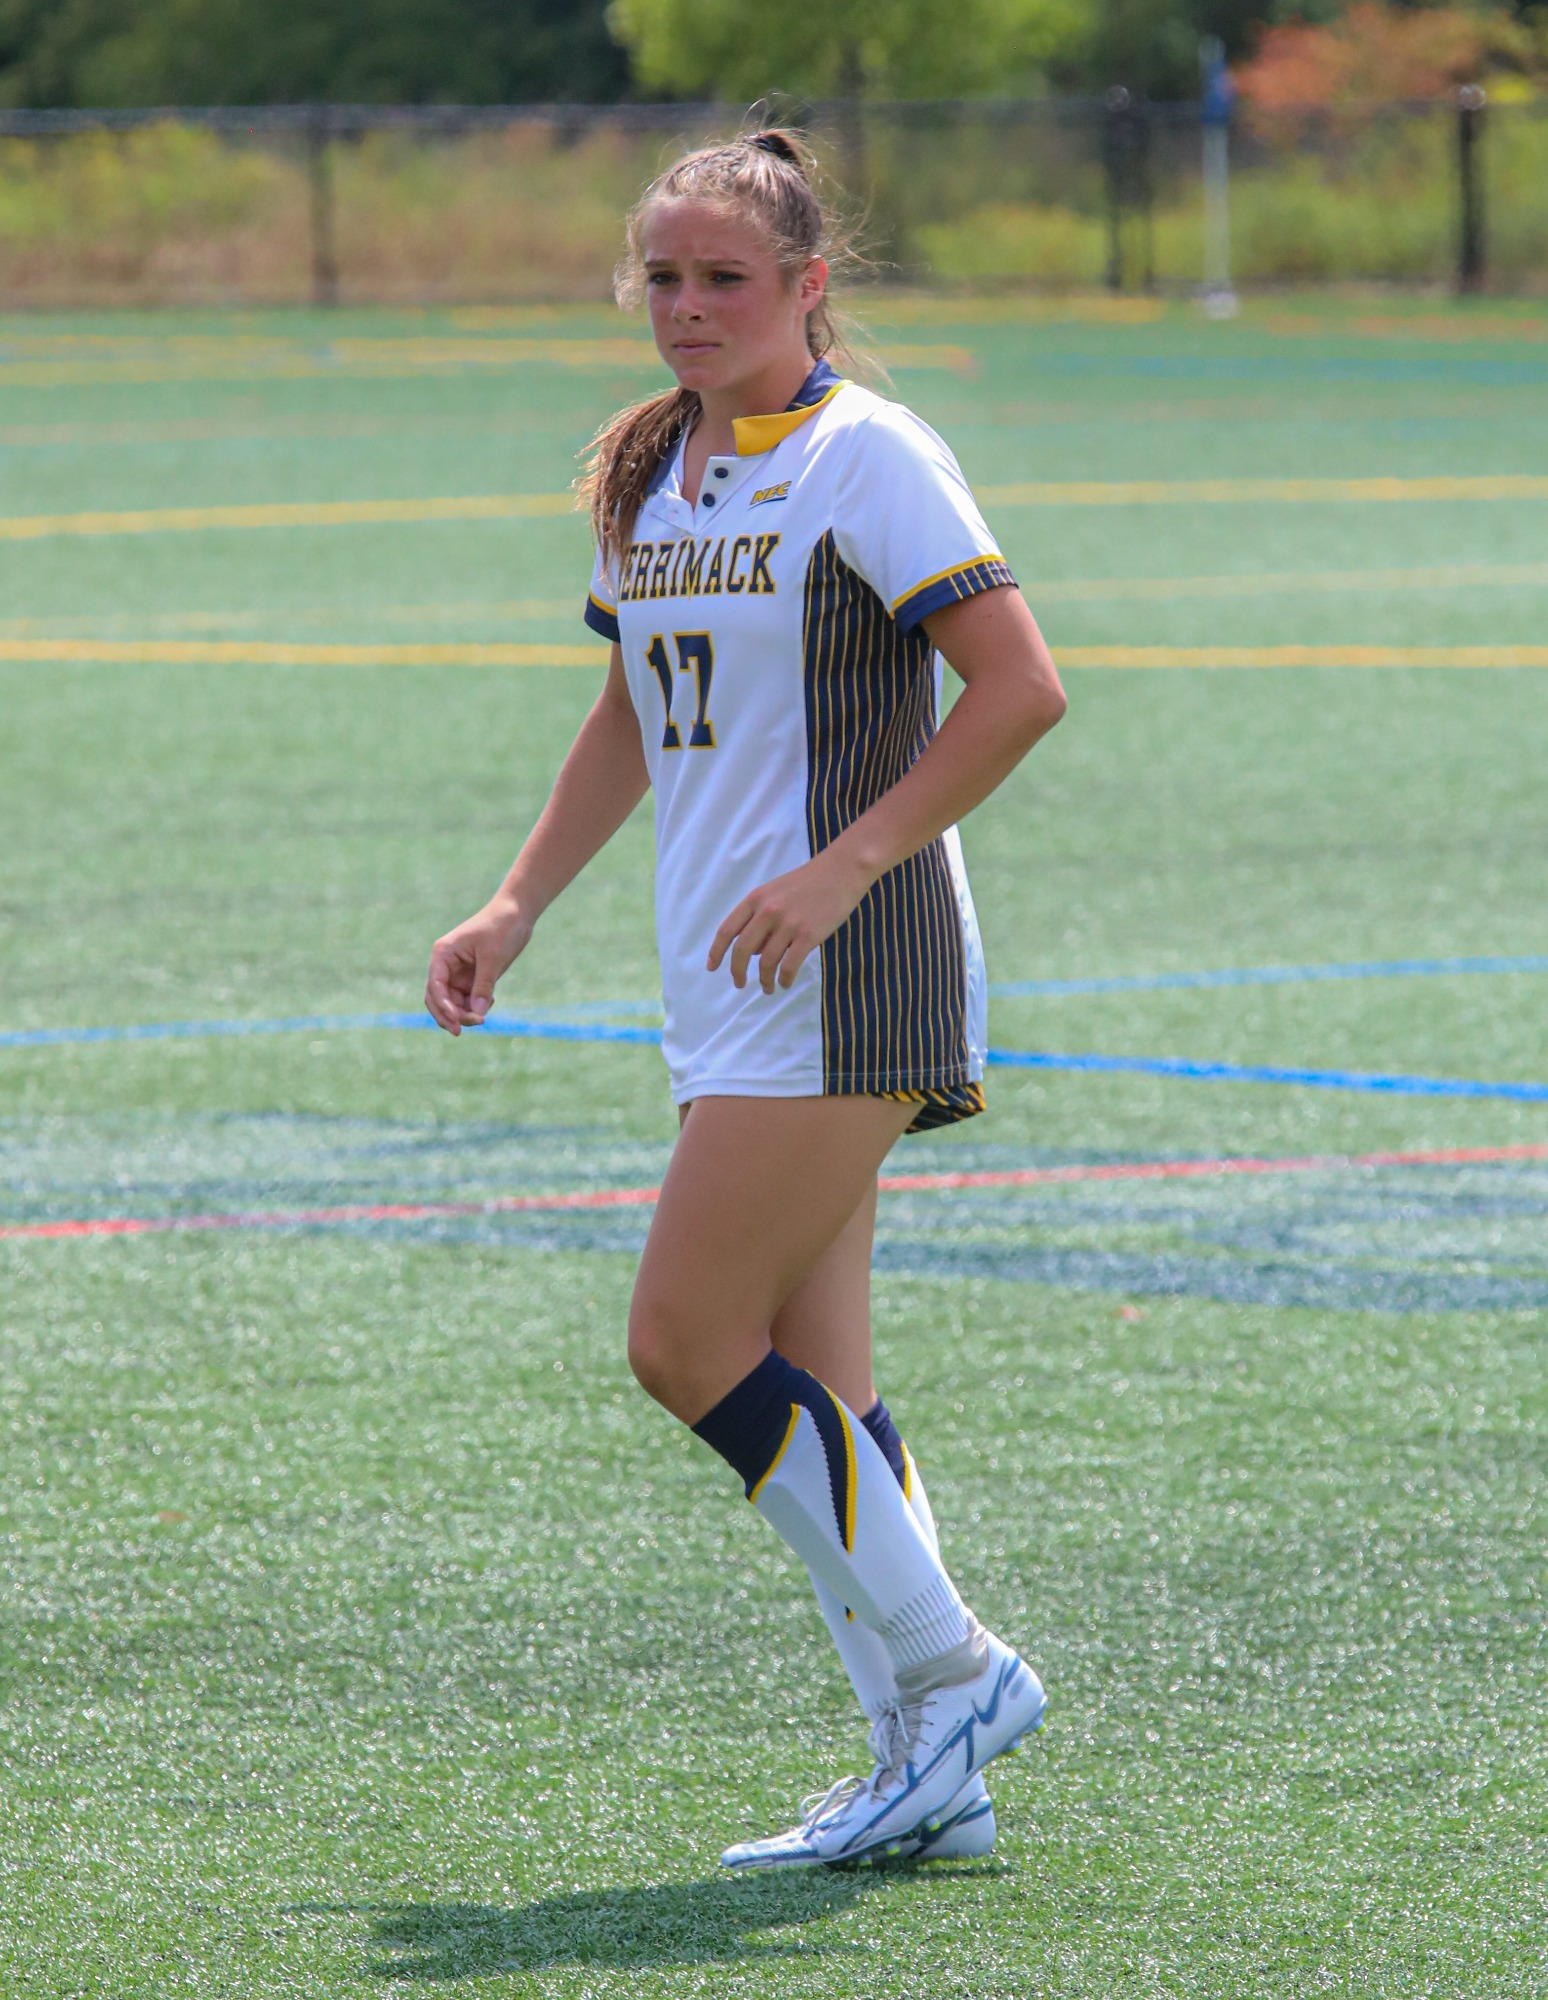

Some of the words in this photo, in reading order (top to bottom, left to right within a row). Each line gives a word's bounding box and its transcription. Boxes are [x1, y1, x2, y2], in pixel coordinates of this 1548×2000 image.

[749, 480, 792, 506] NEC
[617, 532, 781, 603] ERRIMACK
[645, 630, 717, 751] 17
